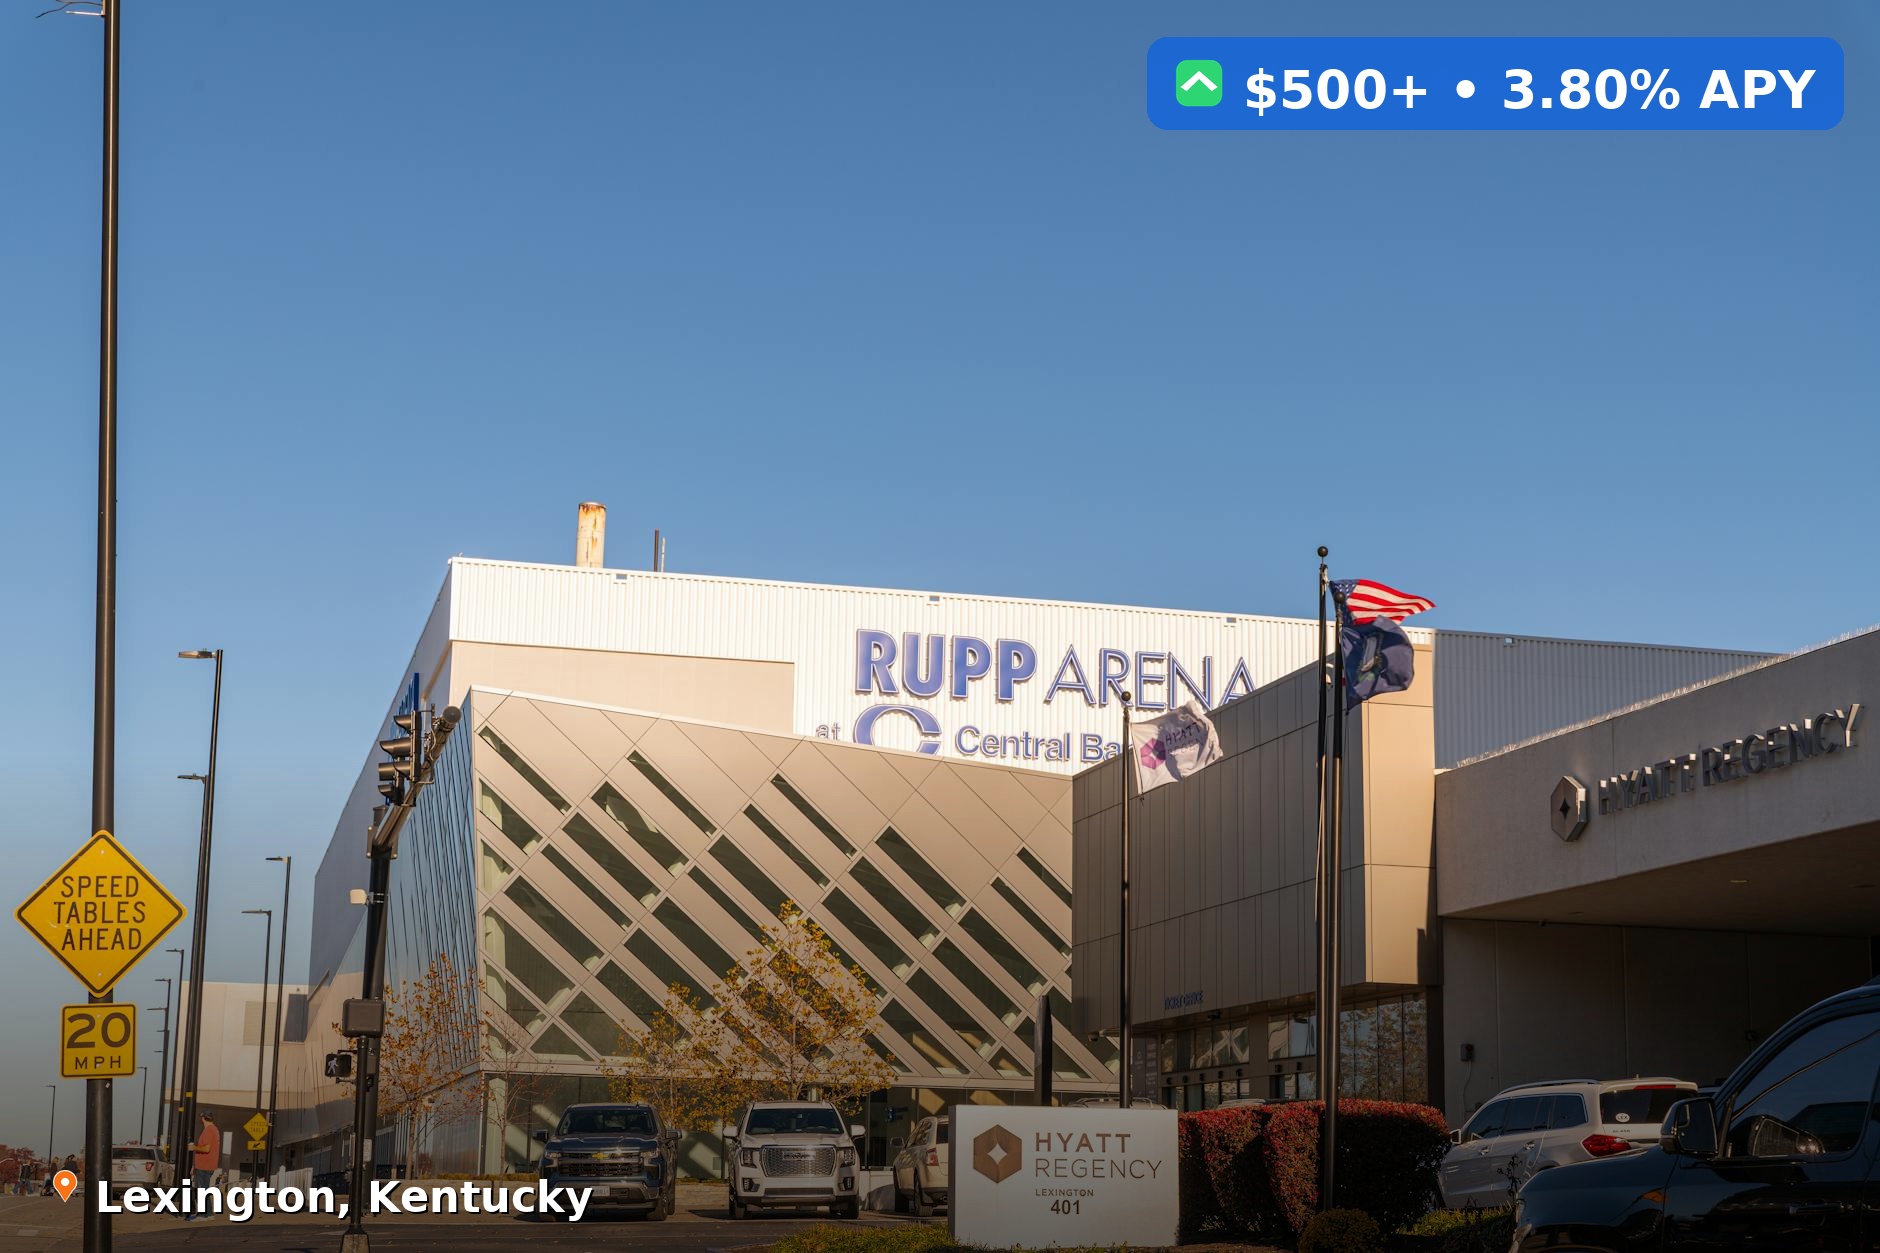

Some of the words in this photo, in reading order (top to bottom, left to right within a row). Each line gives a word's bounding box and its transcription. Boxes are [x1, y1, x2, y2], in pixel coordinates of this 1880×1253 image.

[855, 628, 1037, 701] RUPP
[1044, 643, 1257, 711] ARENA
[955, 724, 1071, 761] Central
[1598, 753, 1697, 816] HYATT
[1701, 703, 1862, 787] REGENCY
[60, 875, 139, 898] SPEED
[53, 901, 146, 924] TABLES
[61, 928, 142, 950] AHEAD
[66, 1011, 131, 1048] 20
[74, 1055, 122, 1070] MPH
[1035, 1132, 1131, 1153] HYATT
[1035, 1158, 1162, 1179] REGENCY
[1035, 1188, 1094, 1197] LEXINGTON
[1050, 1200, 1081, 1215] 401
